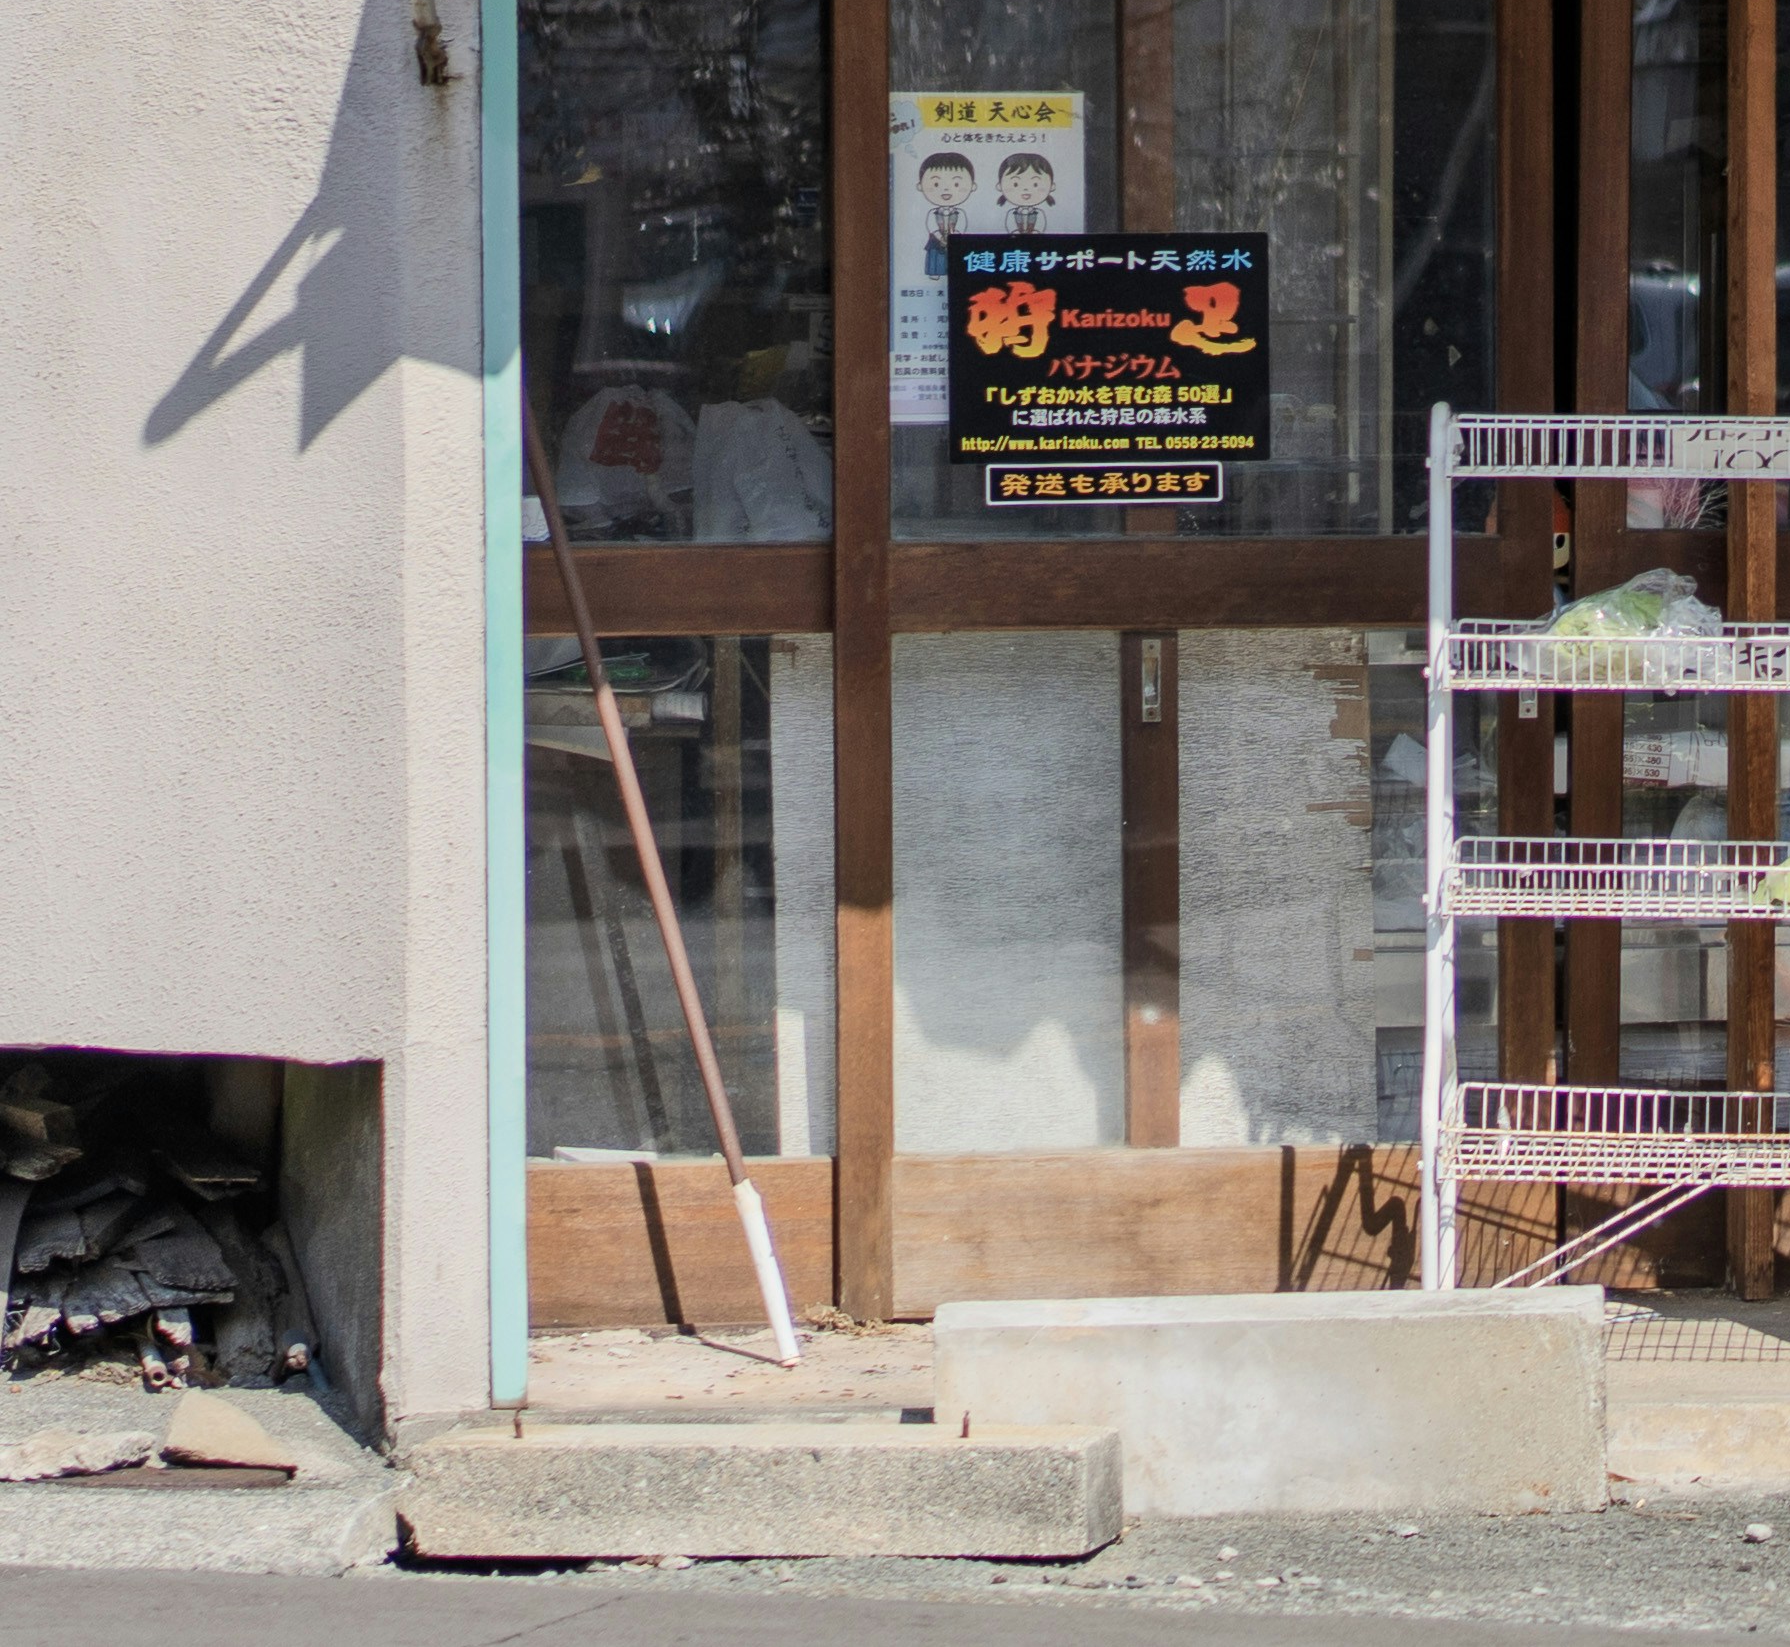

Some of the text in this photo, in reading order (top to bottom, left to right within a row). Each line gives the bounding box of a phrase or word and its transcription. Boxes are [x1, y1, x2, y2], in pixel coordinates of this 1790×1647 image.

[934, 101, 1056, 123] 剣道 天心会
[941, 132, 1047, 144] 心と体をきたえよう！
[963, 248, 1253, 274] 健康サポート天然水
[1060, 309, 1171, 328] Karizoku
[985, 385, 1233, 405] 「しずおか水を育む森 50選」
[1012, 407, 1207, 427] に選ばれた狩足の森水系
[961, 435, 1254, 453] http://www.karizoku.com TEL 0558-23-5094
[999, 472, 1211, 497] 発送も承ります
